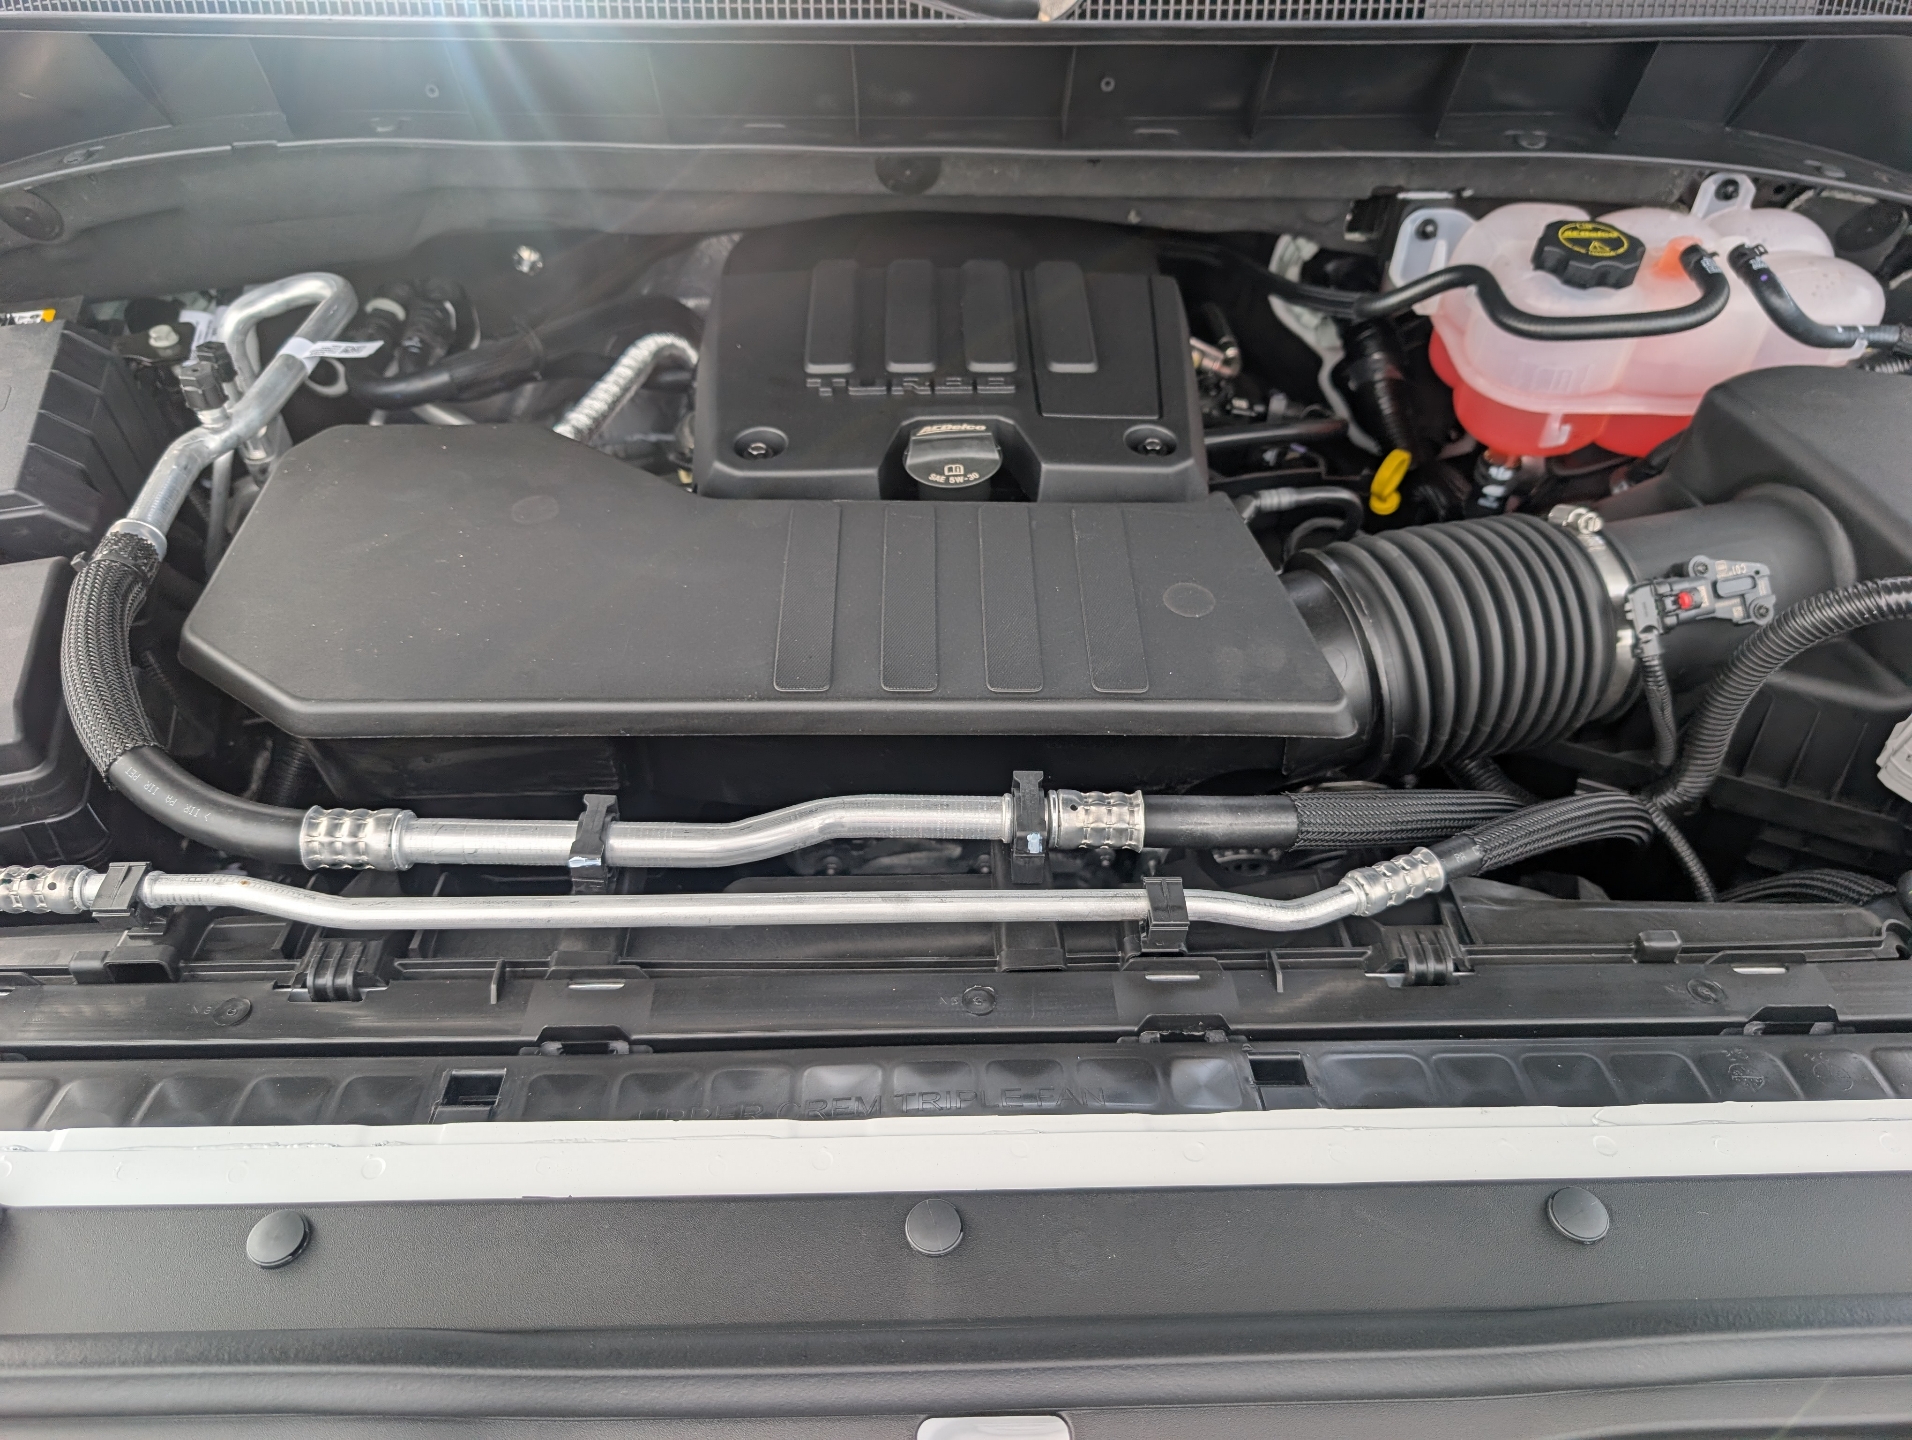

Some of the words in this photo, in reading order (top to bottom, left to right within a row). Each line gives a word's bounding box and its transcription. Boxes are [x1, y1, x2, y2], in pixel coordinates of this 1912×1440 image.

[916, 424, 987, 436] ACDelco
[928, 473, 947, 484] SAE
[949, 472, 980, 484] 5W-30
[124, 766, 142, 781] PET
[894, 1088, 1023, 1113] TRIPLE
[1036, 1087, 1107, 1108] FAN
